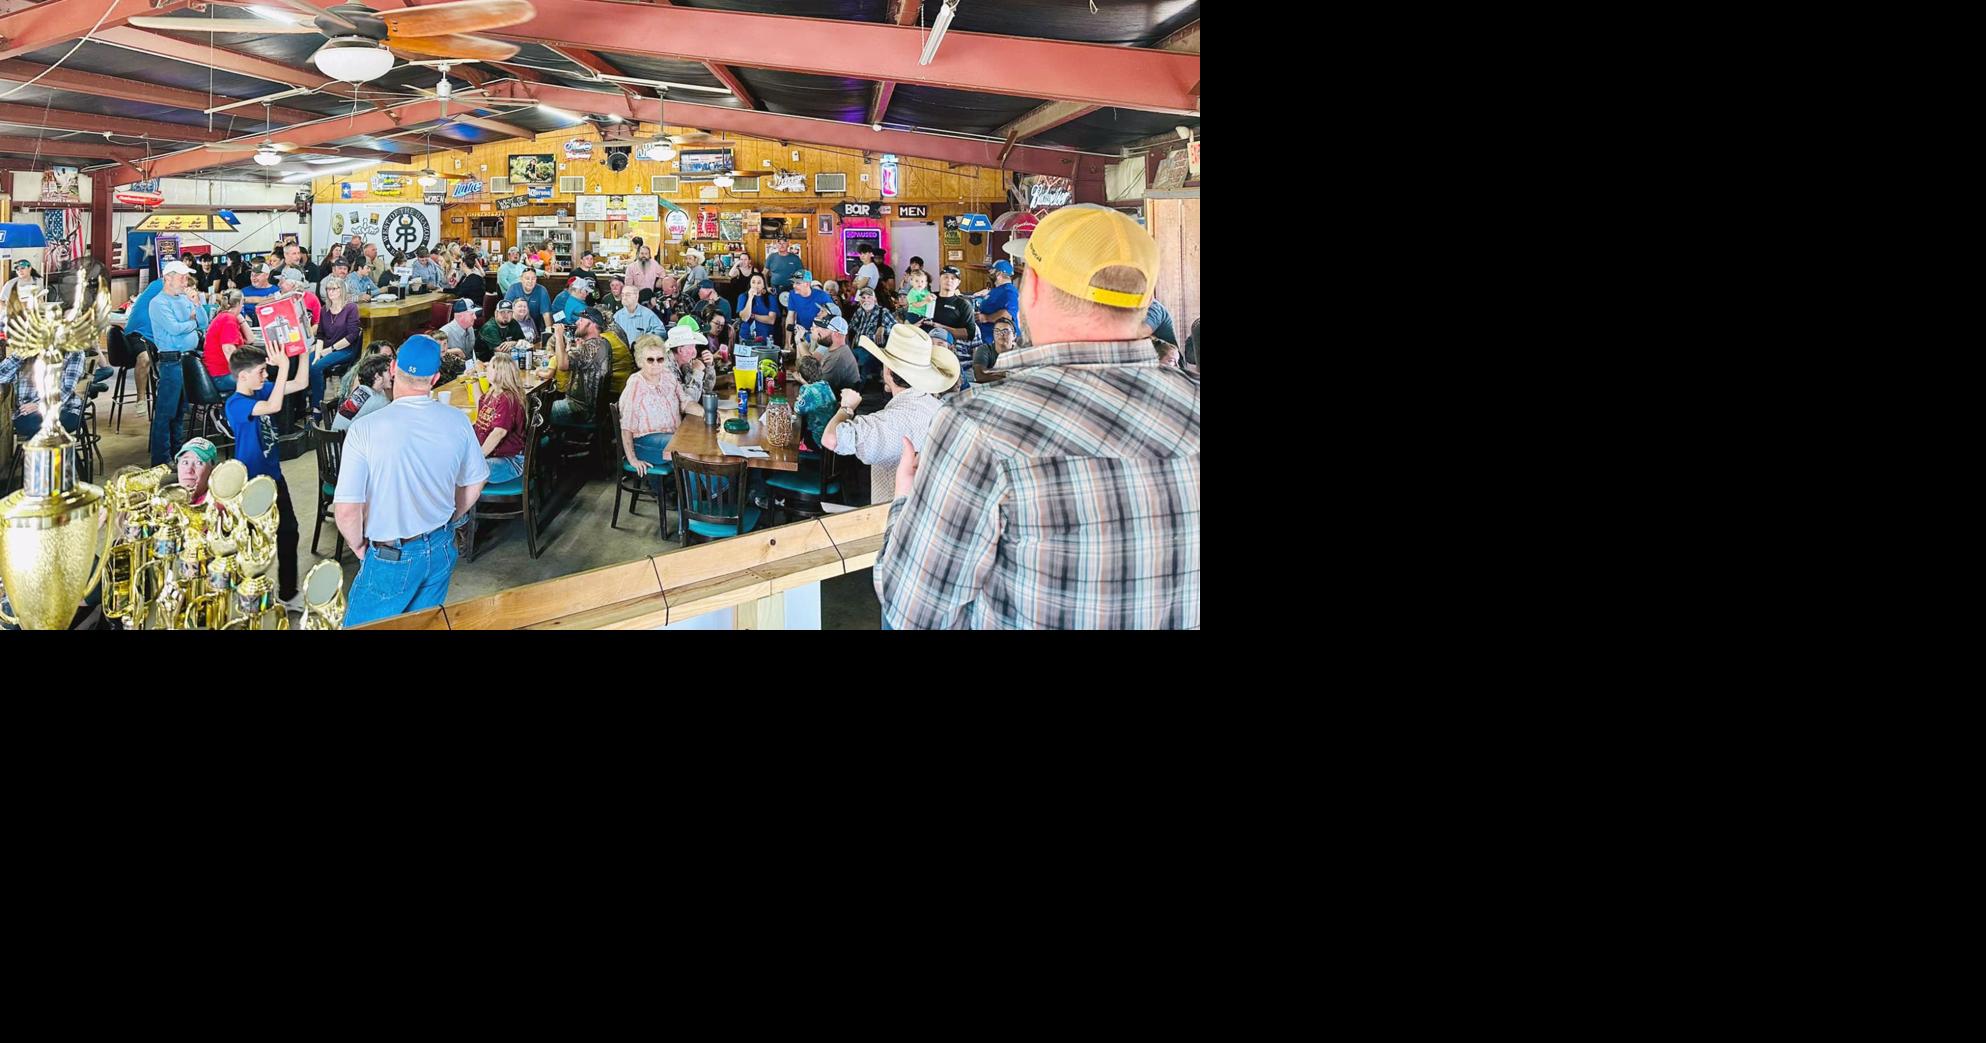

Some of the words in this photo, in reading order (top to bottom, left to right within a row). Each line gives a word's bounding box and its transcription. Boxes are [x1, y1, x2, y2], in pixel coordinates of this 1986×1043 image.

[424, 195, 445, 203] WOMEN
[900, 206, 926, 216] MEN
[389, 209, 399, 220] OF
[399, 207, 414, 215] THE
[415, 211, 430, 242] BRAZOS
